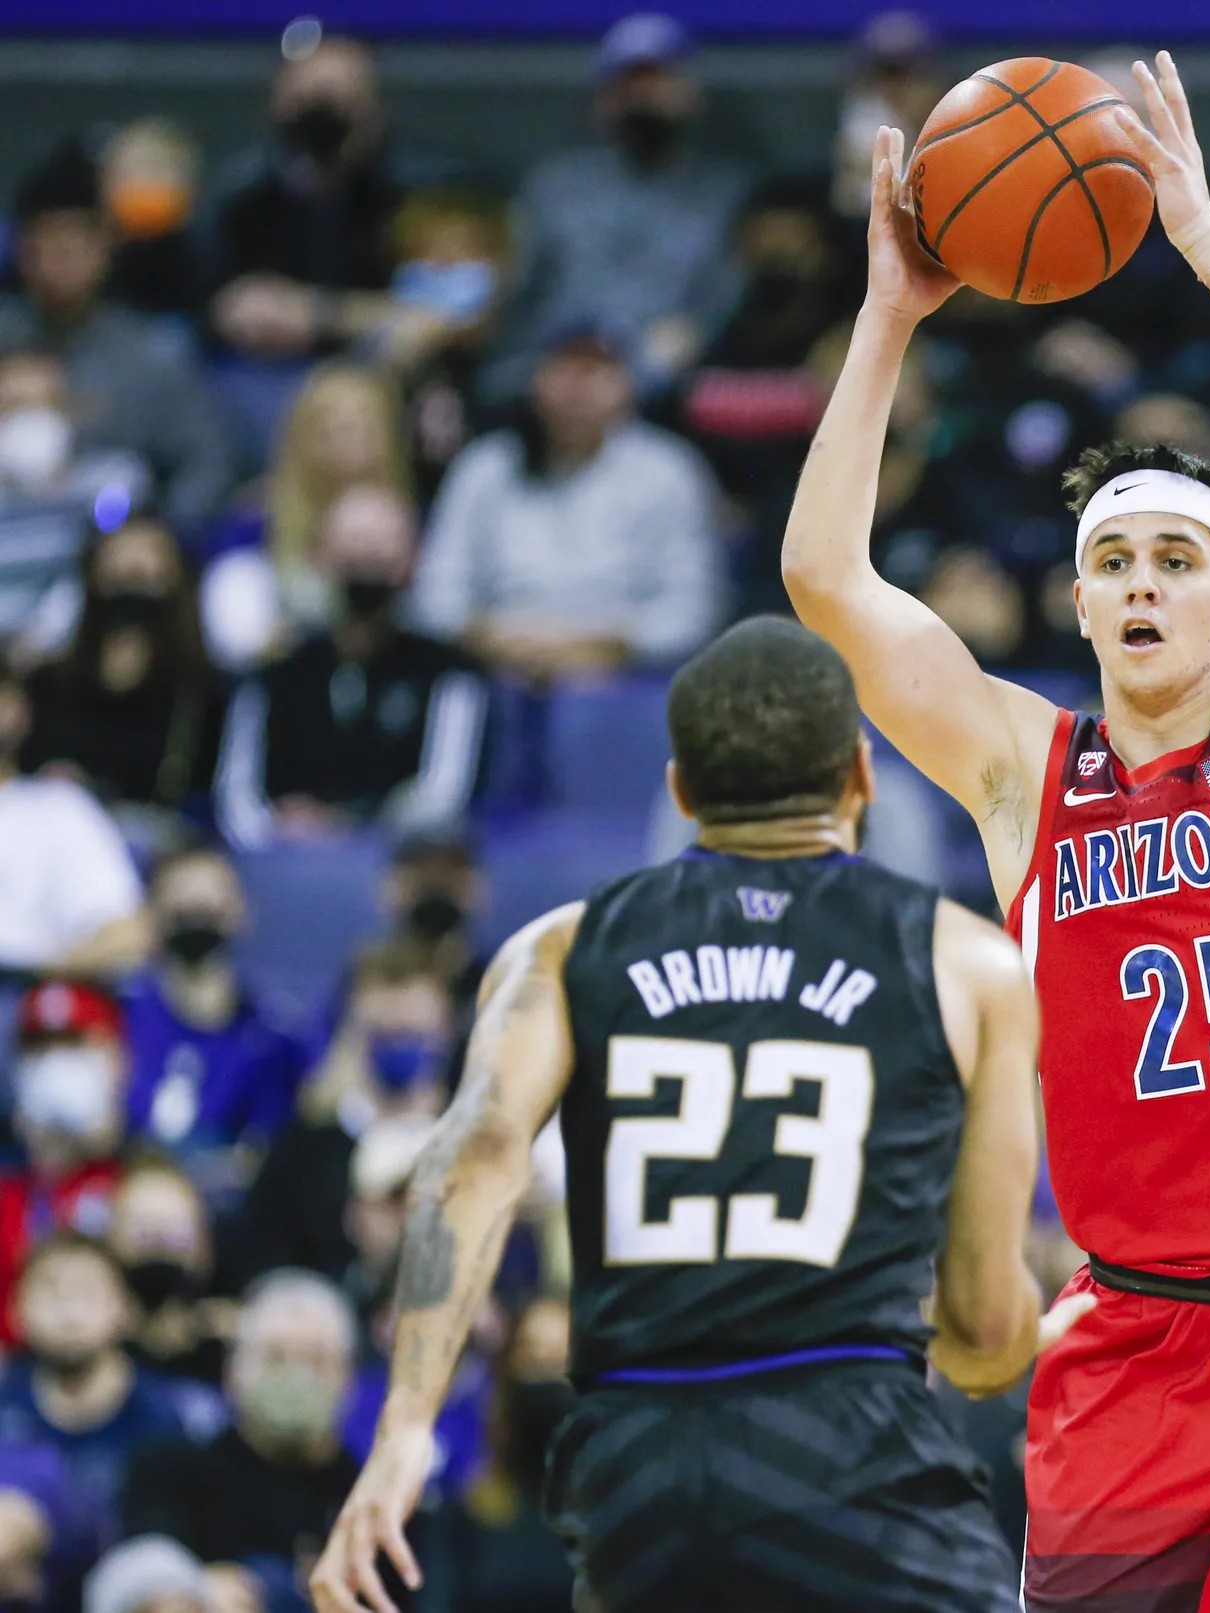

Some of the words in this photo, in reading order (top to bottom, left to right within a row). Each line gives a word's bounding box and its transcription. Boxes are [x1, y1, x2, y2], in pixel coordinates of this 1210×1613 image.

[627, 944, 796, 1019] BROWN
[799, 958, 877, 1026] JR
[603, 1034, 876, 1268] 23
